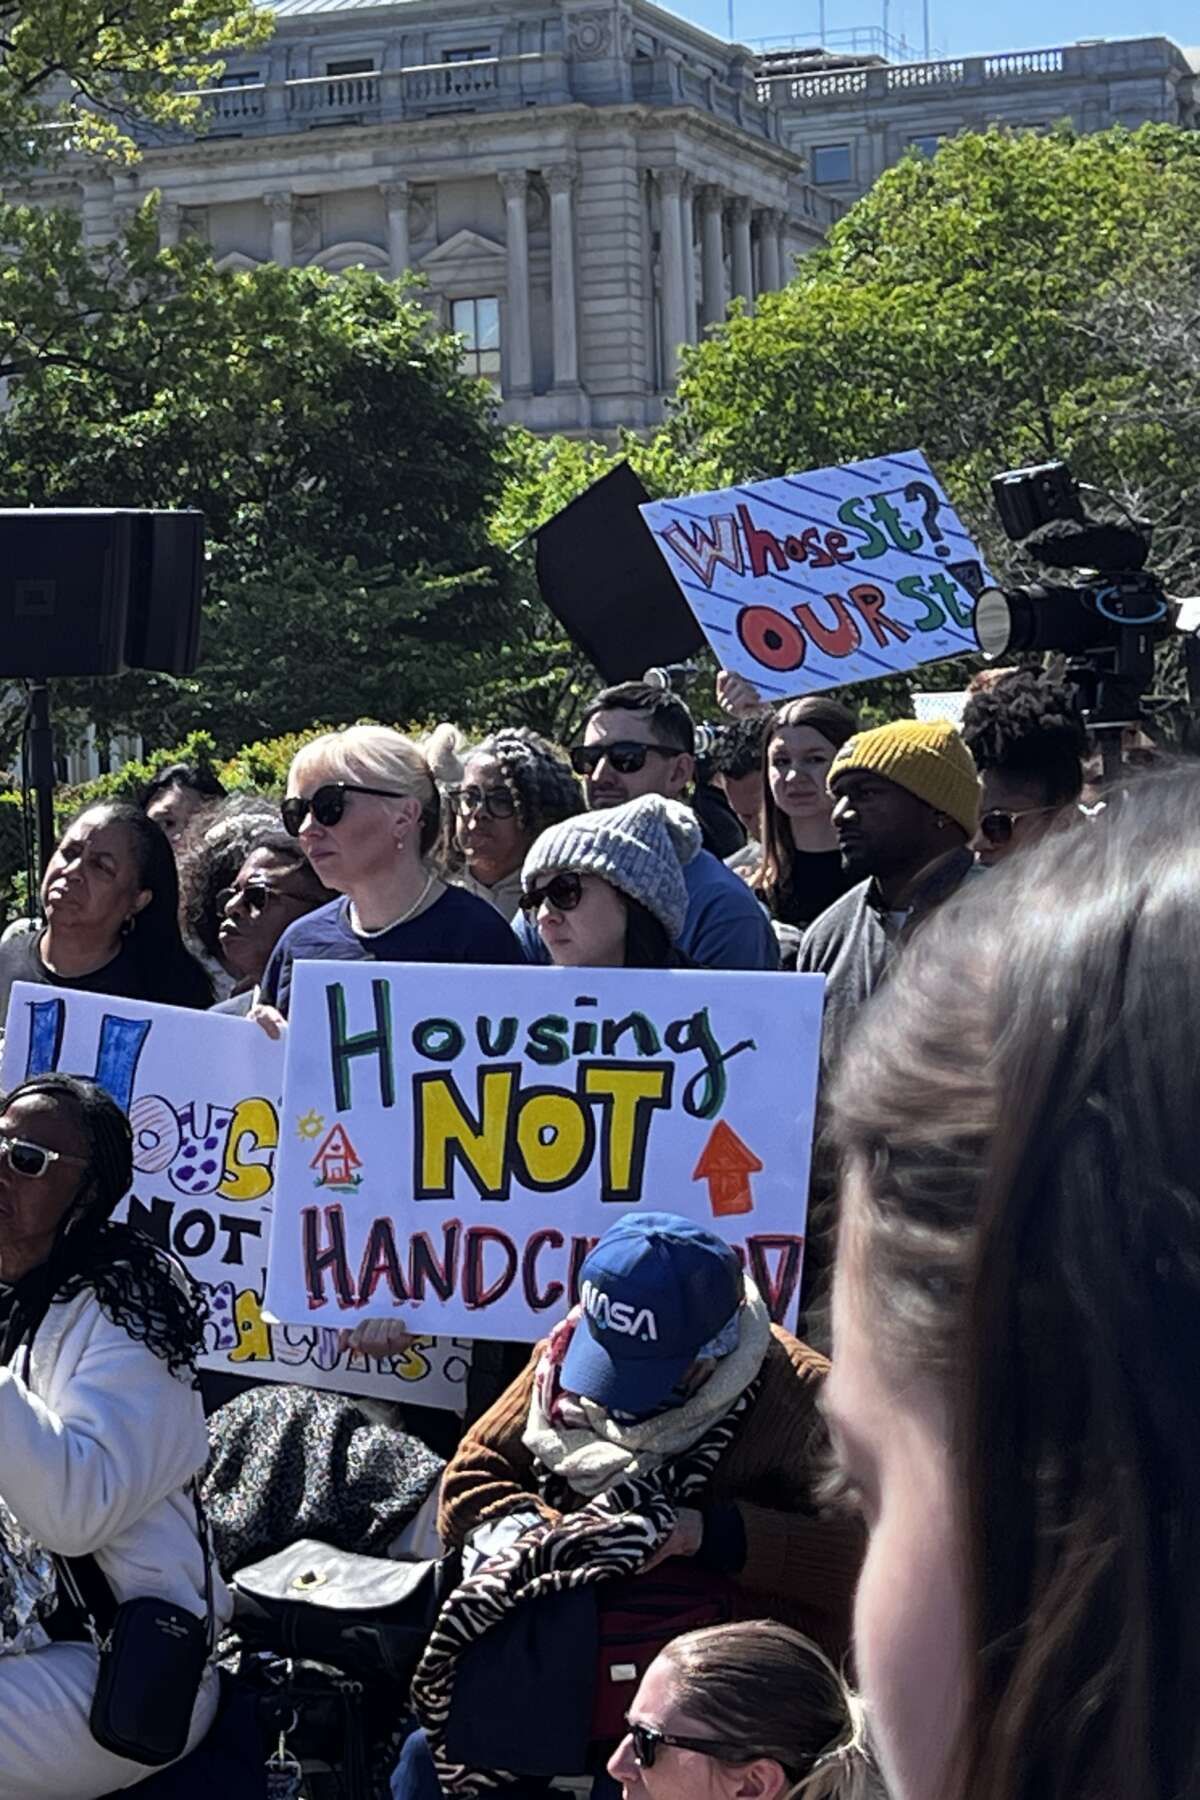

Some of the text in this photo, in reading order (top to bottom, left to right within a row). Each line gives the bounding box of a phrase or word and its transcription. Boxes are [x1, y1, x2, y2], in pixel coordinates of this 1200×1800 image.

[660, 503, 856, 588] Whose
[736, 583, 911, 673] OUR
[325, 979, 757, 1120] Housing
[412, 1060, 675, 1202] NOT
[126, 1196, 262, 1265] NOT
[582, 1279, 658, 1341] NASA
